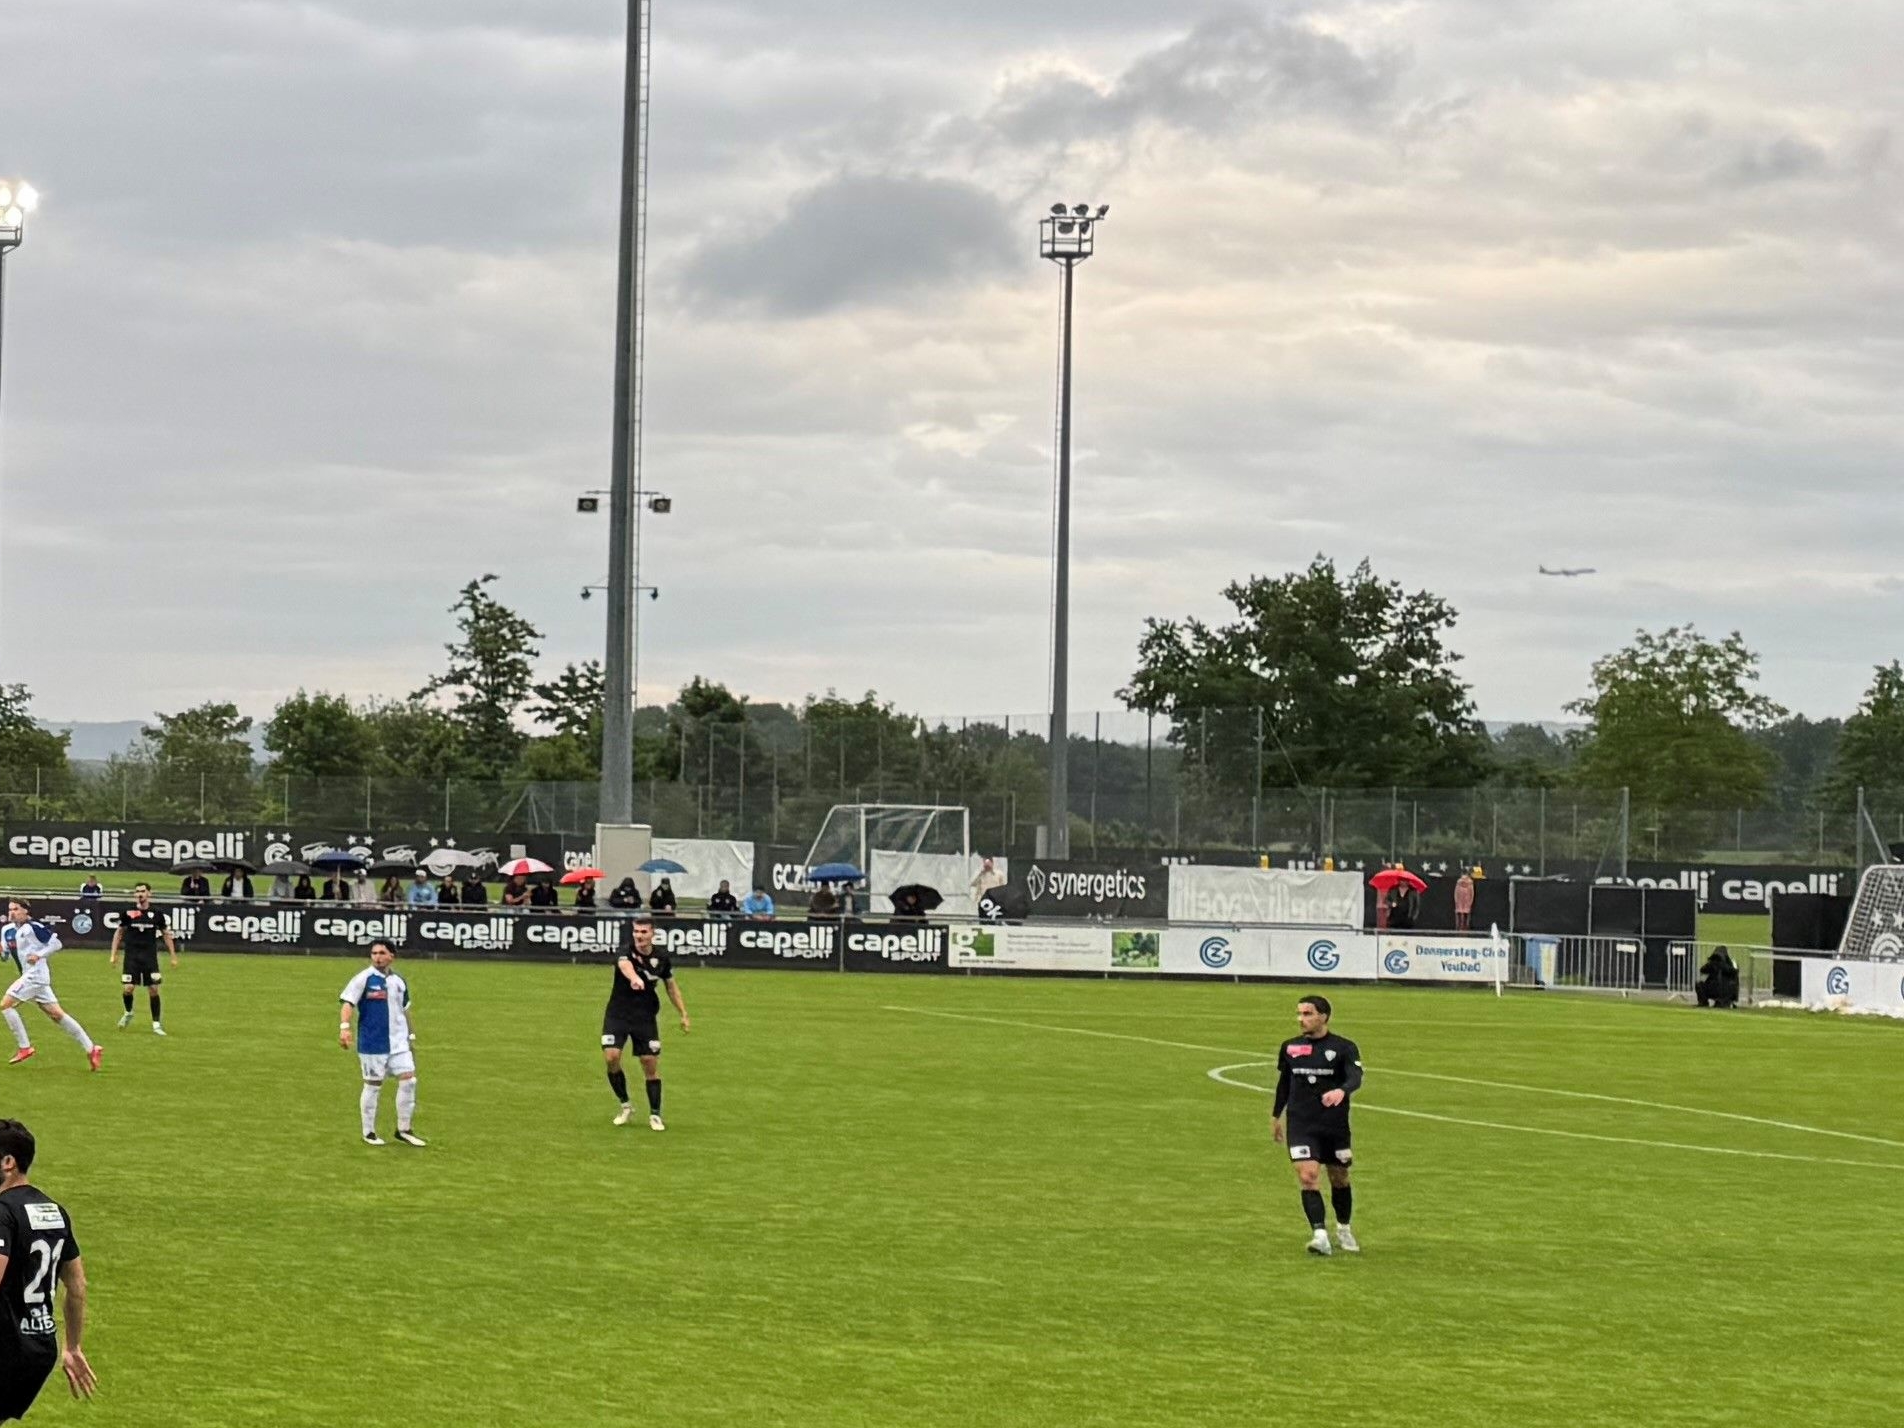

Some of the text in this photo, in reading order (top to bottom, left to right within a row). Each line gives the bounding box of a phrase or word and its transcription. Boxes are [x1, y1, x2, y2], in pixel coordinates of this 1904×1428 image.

[9, 830, 120, 863] capelli
[132, 832, 244, 865] capelli
[60, 856, 119, 868] SPORT
[1049, 868, 1146, 902] synergetics
[208, 911, 302, 939] capelli
[250, 933, 300, 943] SPORT
[314, 914, 407, 943] capelli
[420, 918, 513, 946] capelli
[527, 920, 620, 949] capelli
[652, 923, 727, 952] apelli
[463, 939, 513, 950] SPORT
[570, 942, 619, 953] SPORT
[676, 945, 726, 956] SPORT
[740, 926, 834, 955] capelli
[783, 948, 833, 959] SPORT
[848, 929, 941, 958] capelli
[891, 951, 941, 962] SPORT
